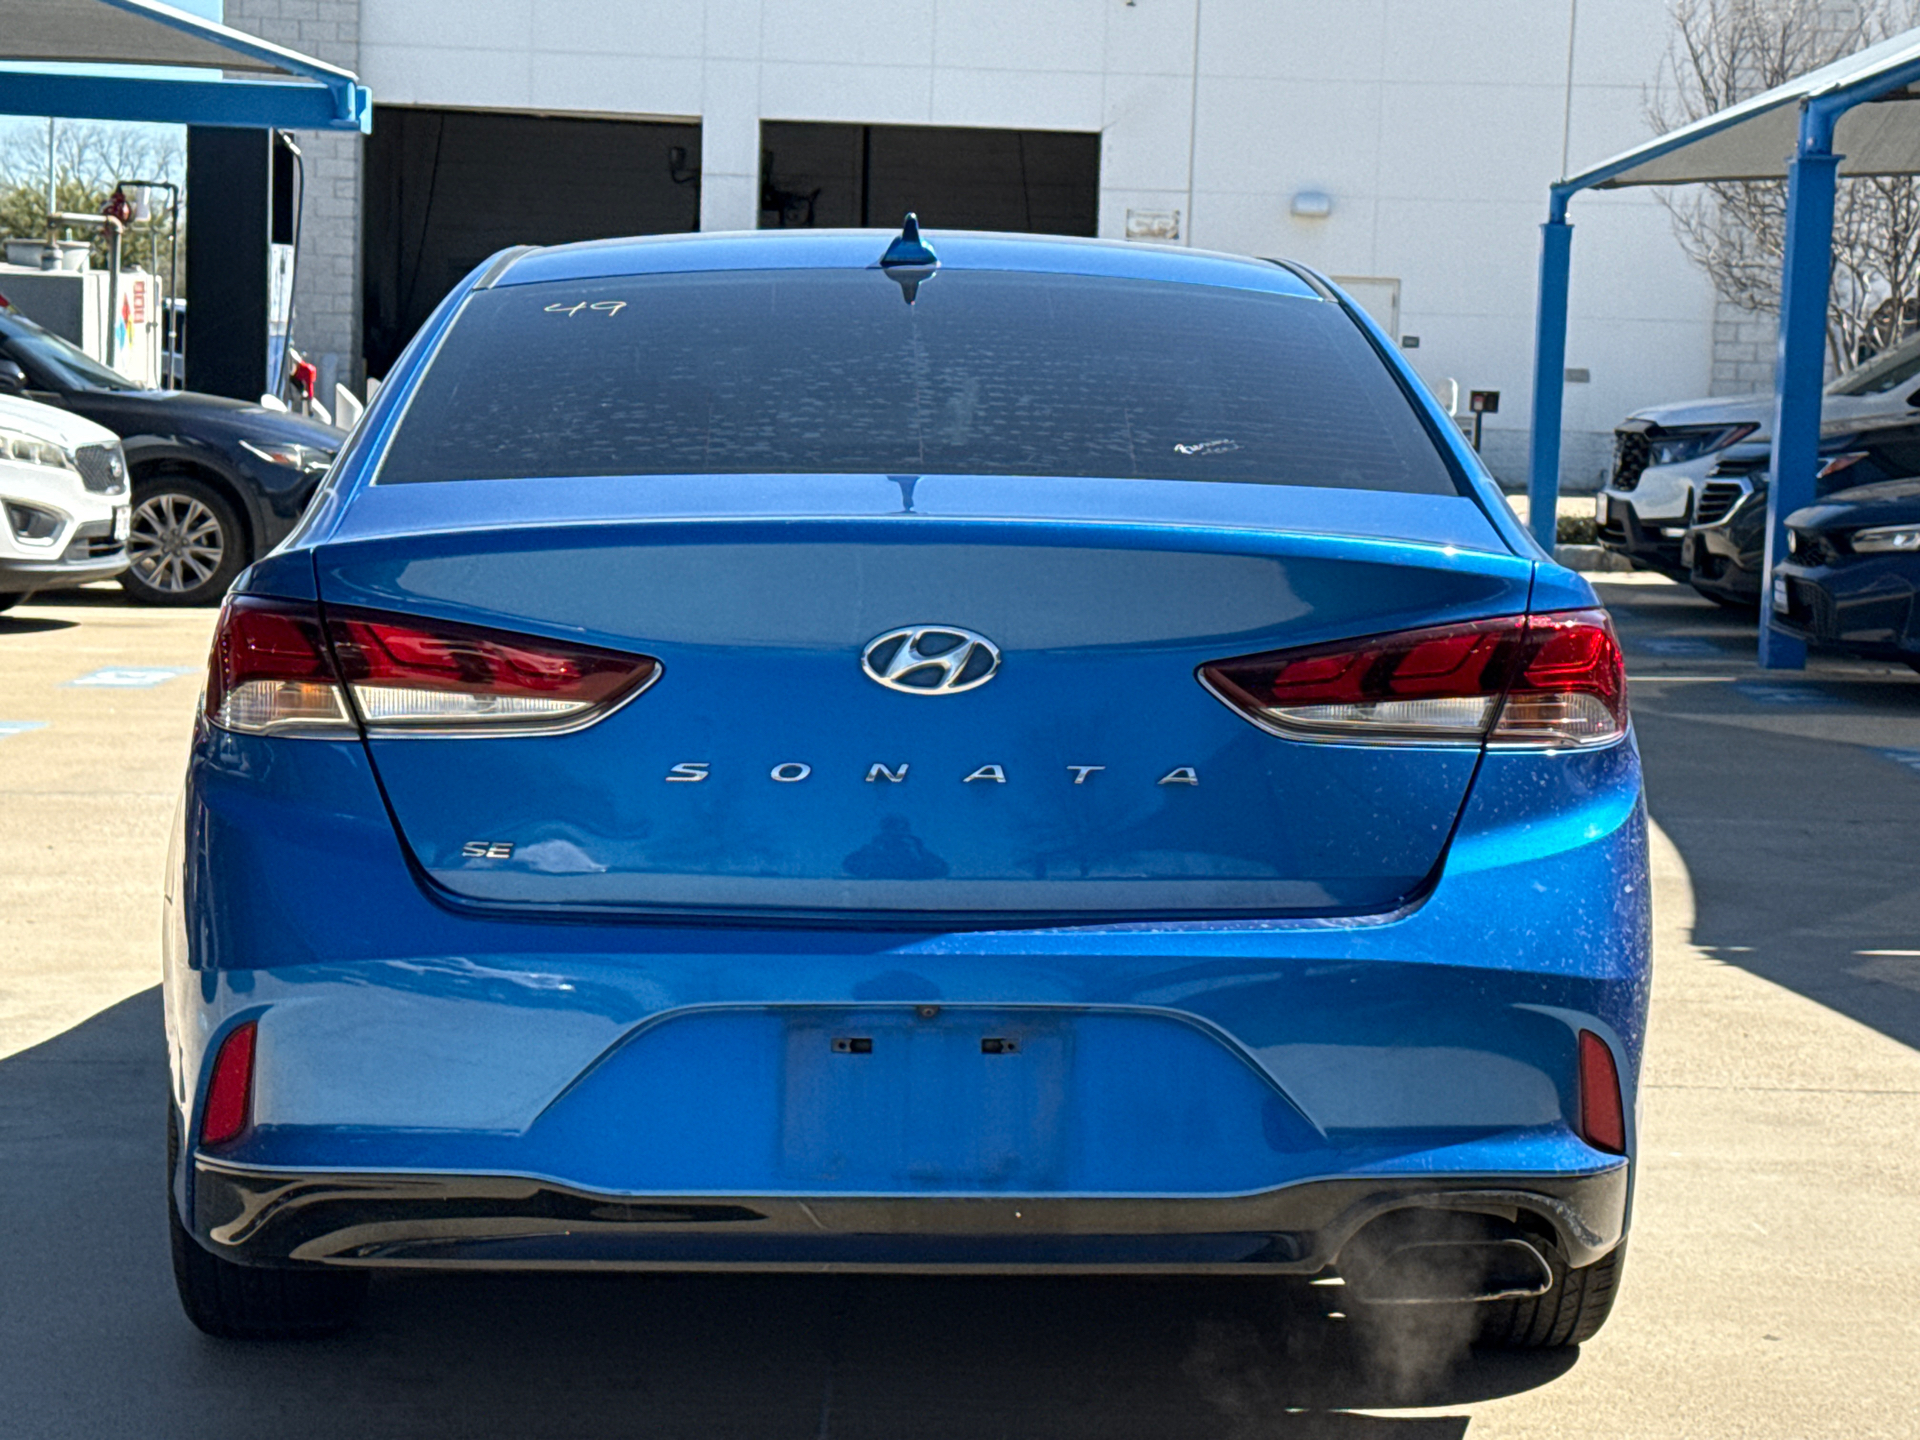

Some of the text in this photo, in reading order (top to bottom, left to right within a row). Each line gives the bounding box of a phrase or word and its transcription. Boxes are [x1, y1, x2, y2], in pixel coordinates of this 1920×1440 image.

[544, 301, 627, 317] 49
[665, 762, 1199, 786] SONATA
[461, 841, 514, 859] SE
